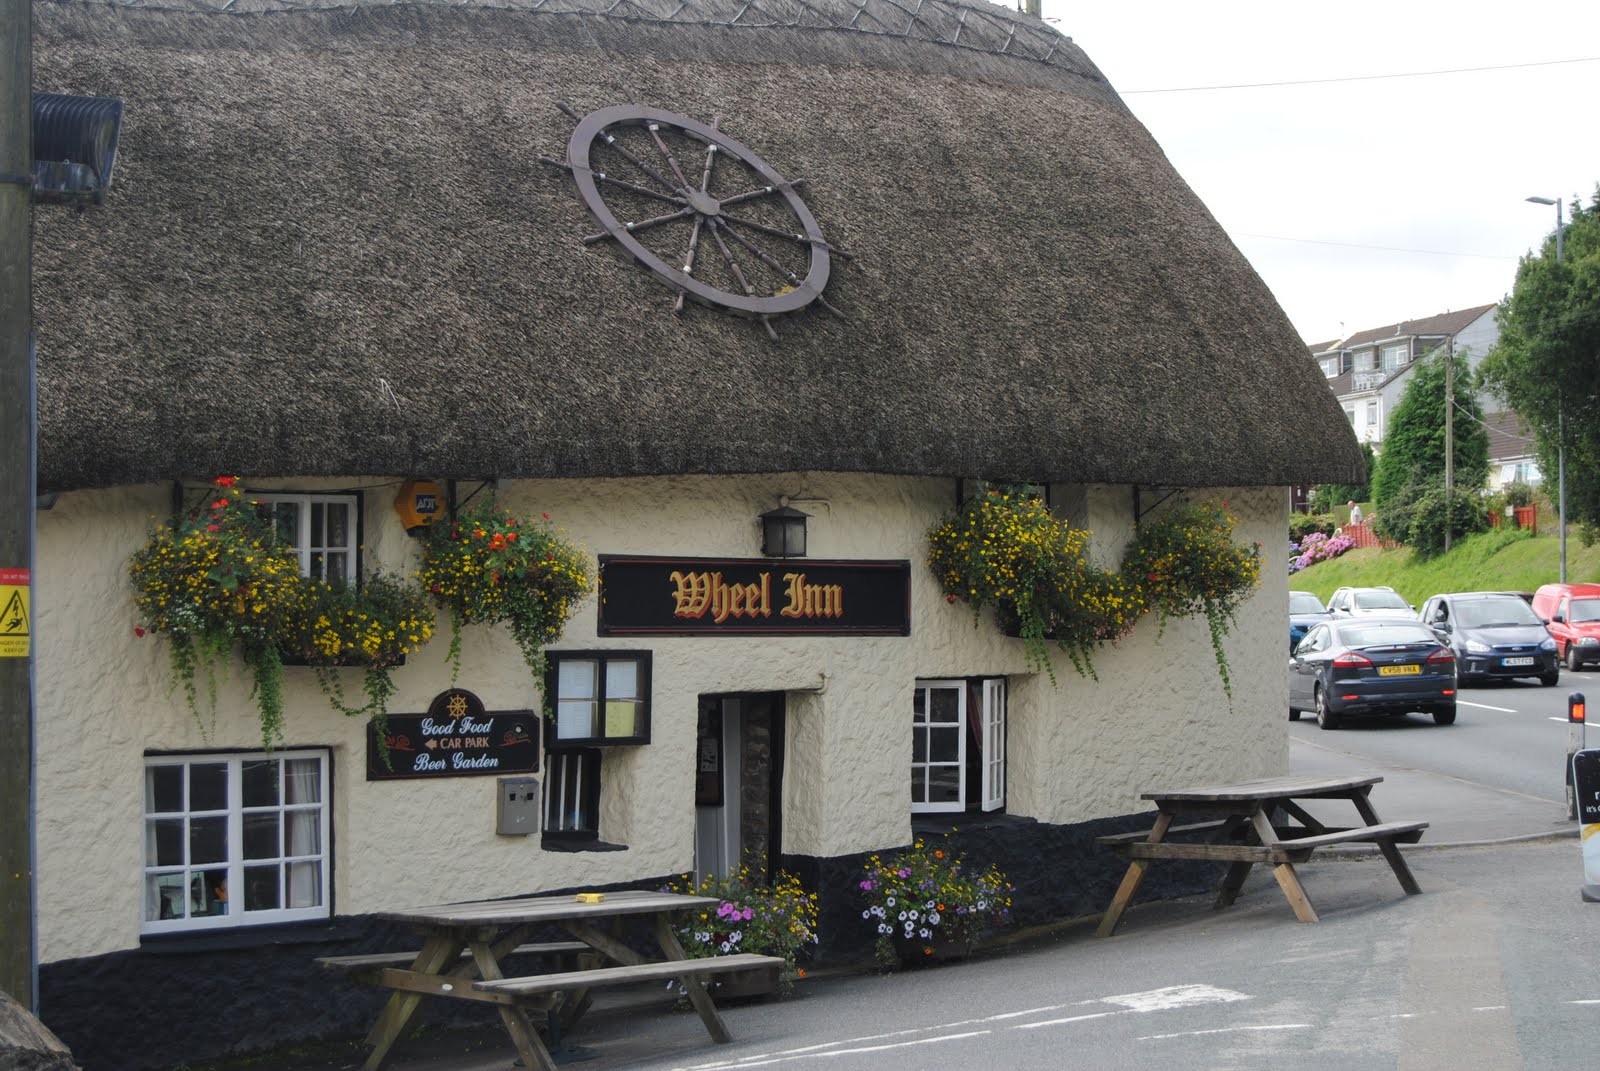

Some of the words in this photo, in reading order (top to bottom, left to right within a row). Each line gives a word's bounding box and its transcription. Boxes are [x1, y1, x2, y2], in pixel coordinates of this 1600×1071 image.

[416, 498, 436, 510] ADT
[670, 570, 771, 624] Wheel
[780, 572, 844, 618] Inn
[421, 717, 456, 736] Good
[459, 715, 494, 734] Food
[440, 738, 462, 749] CAR
[465, 736, 490, 748] PARK
[413, 753, 447, 771] Beer
[452, 751, 499, 769] Garden
